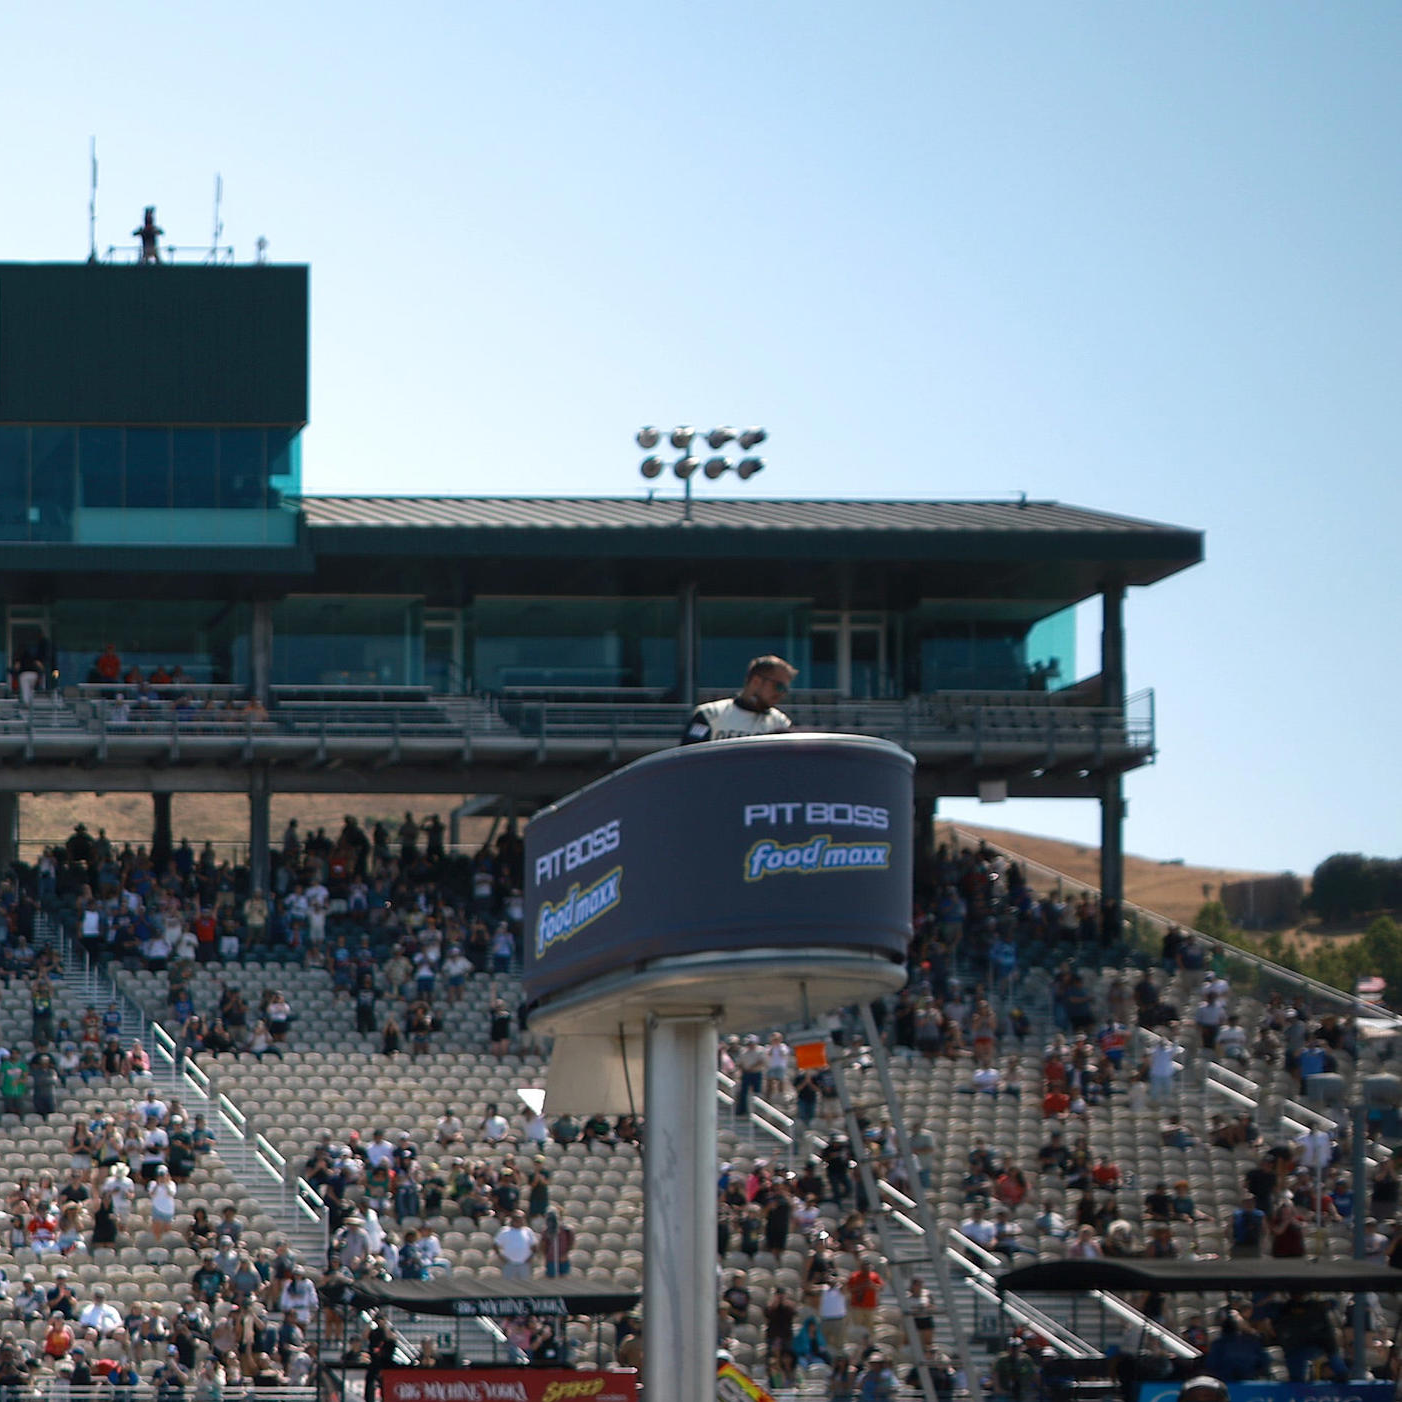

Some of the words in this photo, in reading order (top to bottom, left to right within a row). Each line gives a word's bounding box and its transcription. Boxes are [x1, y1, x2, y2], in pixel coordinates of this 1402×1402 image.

[745, 803, 802, 826] PIT
[805, 803, 889, 829] BOSS
[535, 848, 566, 886] PIT
[566, 820, 620, 872] BOSS
